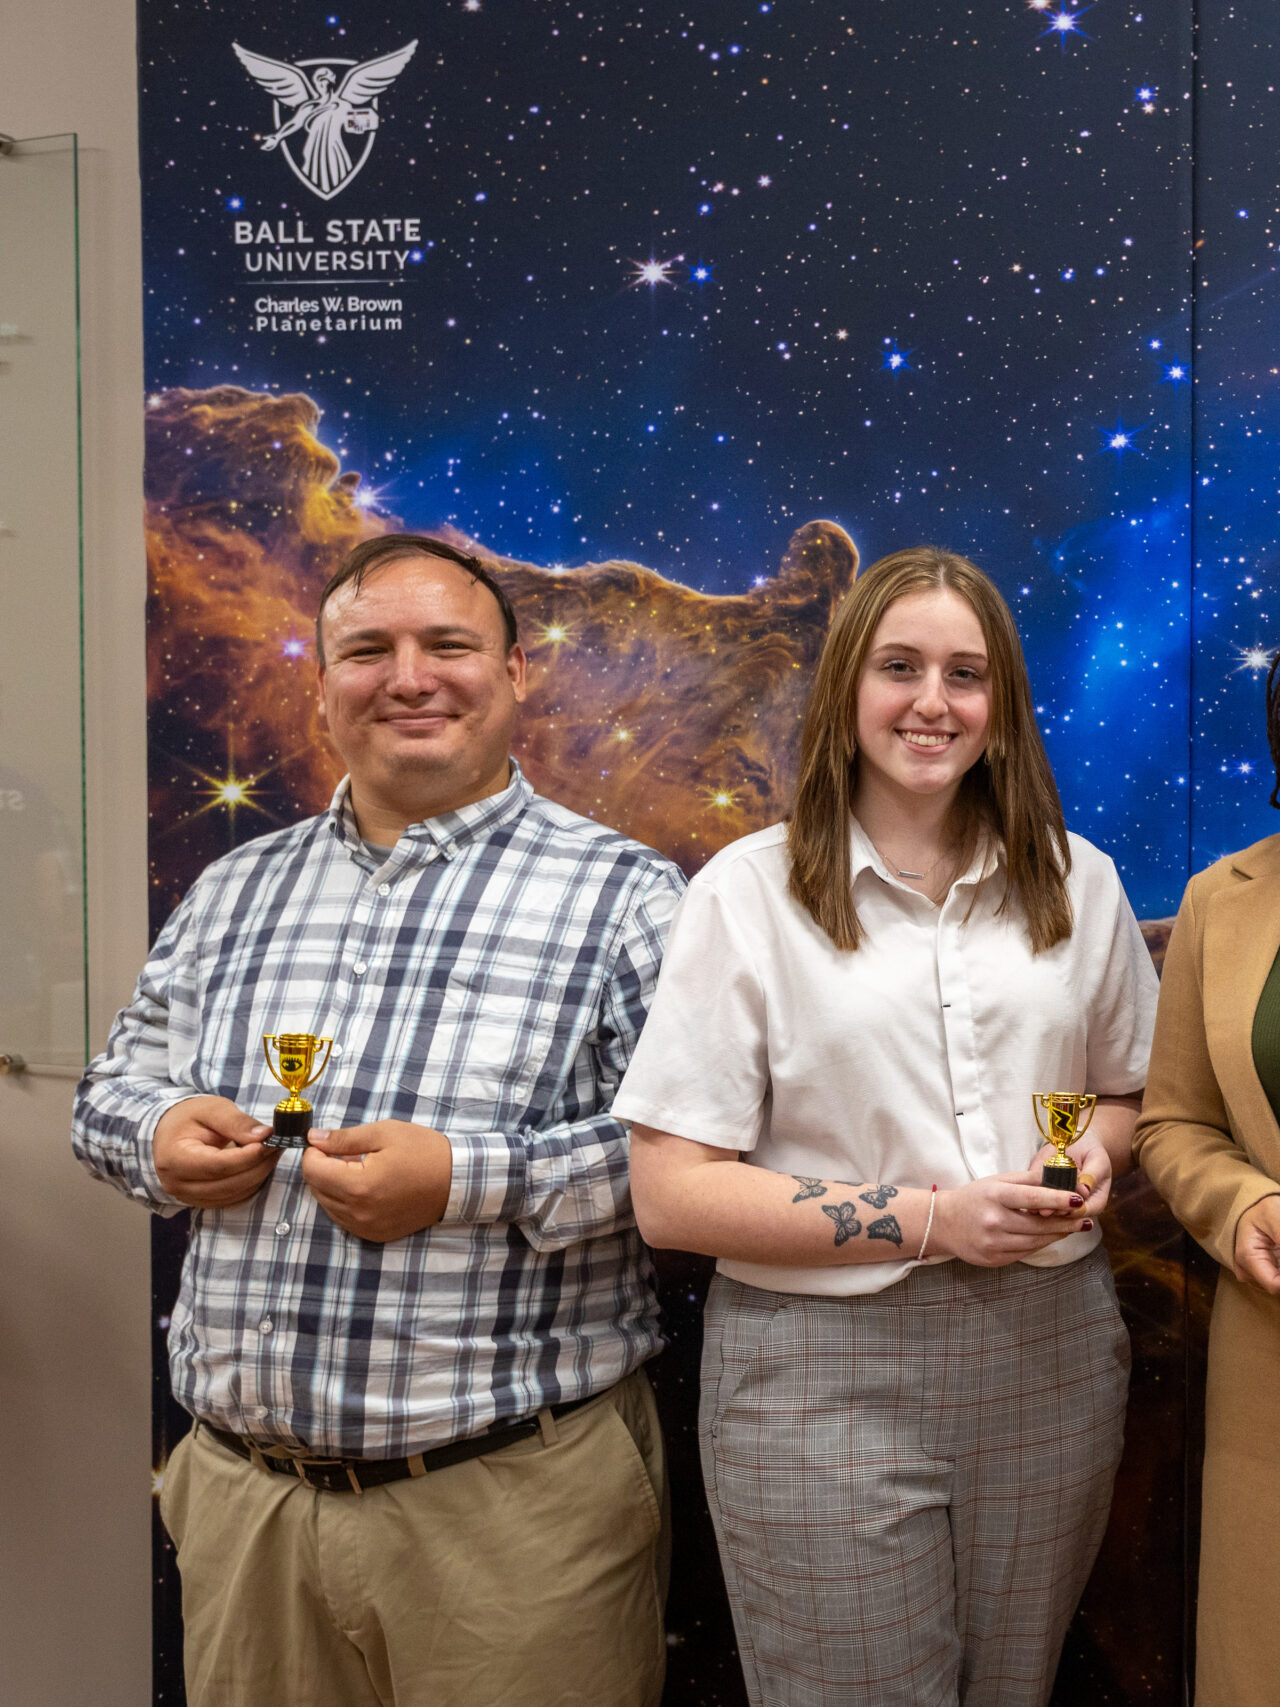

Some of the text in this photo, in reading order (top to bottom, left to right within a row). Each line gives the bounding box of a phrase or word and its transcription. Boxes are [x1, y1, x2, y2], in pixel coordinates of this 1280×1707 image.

[234, 218, 421, 244] BALL STATE
[245, 250, 409, 272] UNIVERSITY
[254, 296, 402, 313] Charles W. Brown
[256, 314, 402, 332] Planetarium
